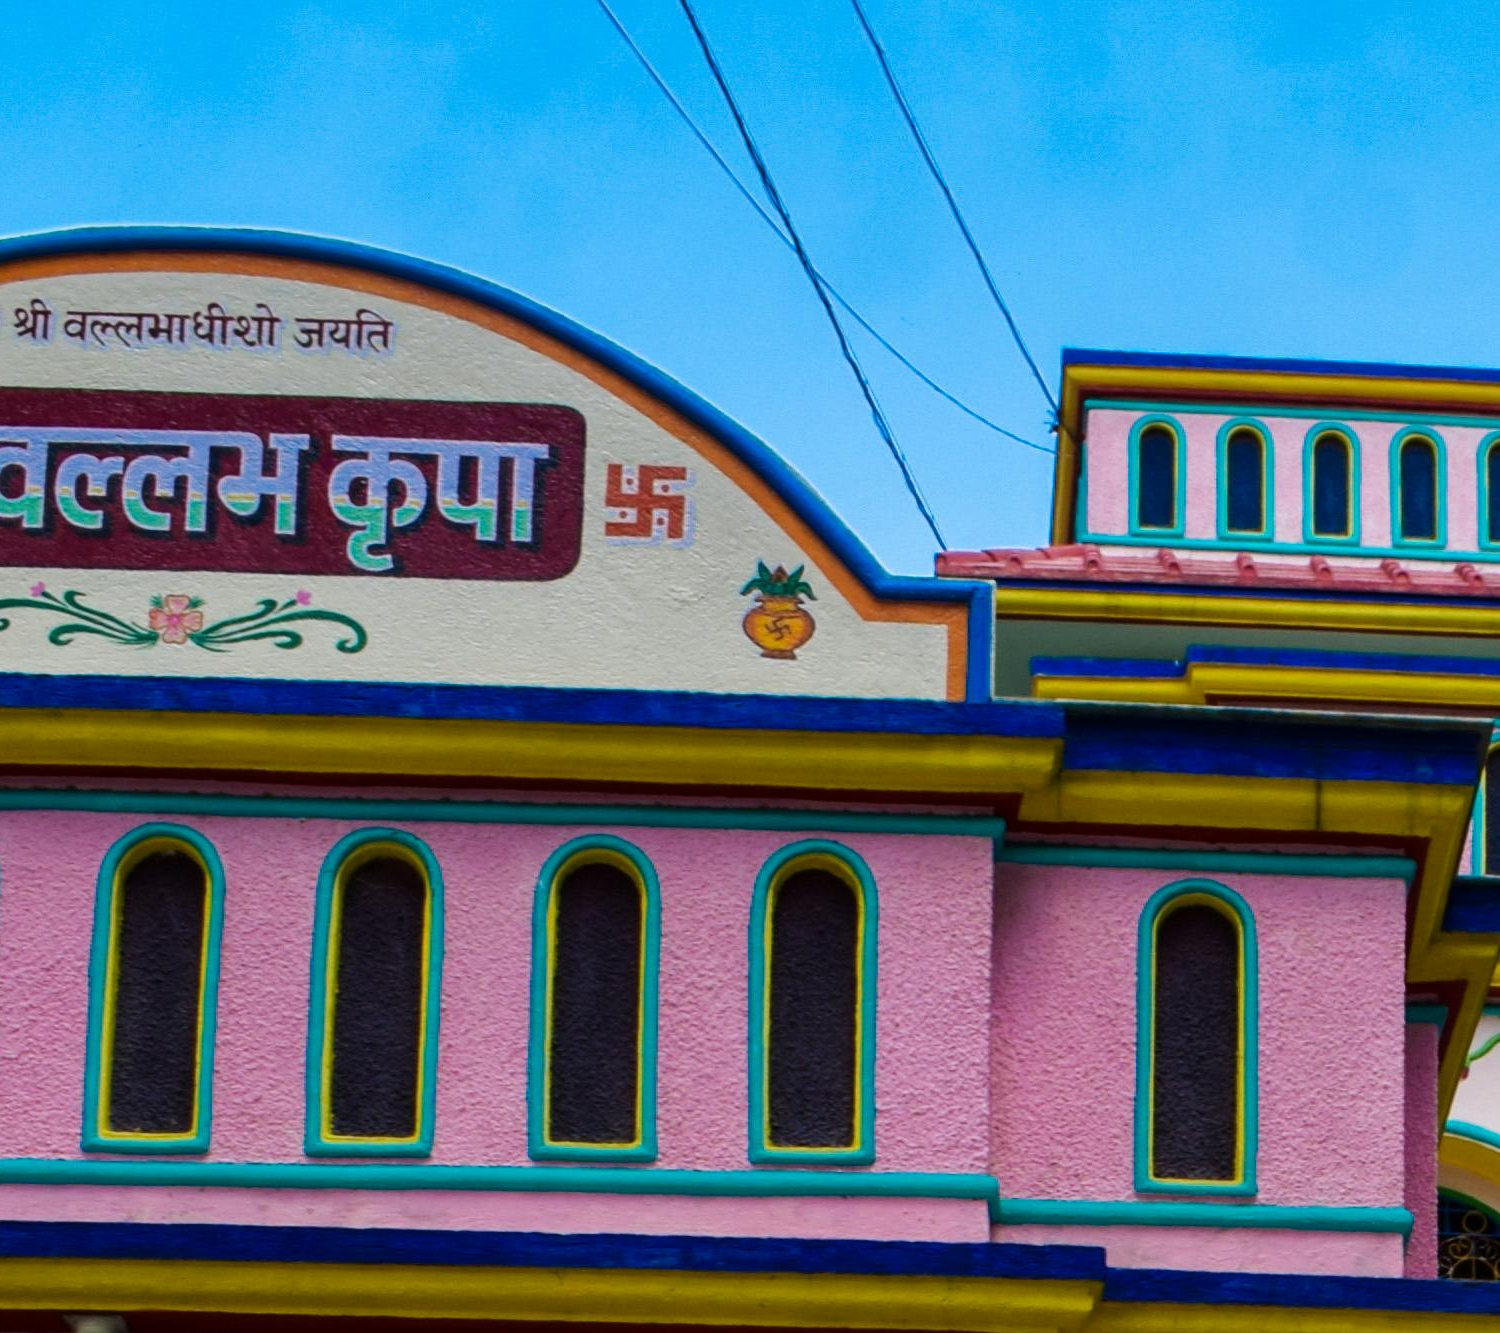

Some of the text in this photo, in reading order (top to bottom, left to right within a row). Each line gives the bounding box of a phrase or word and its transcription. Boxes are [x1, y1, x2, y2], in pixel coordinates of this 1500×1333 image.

[13, 298, 51, 340] श्री
[63, 302, 282, 348] वल्लभाधीशो
[293, 309, 394, 353] जयति
[327, 433, 550, 572] कृपा
